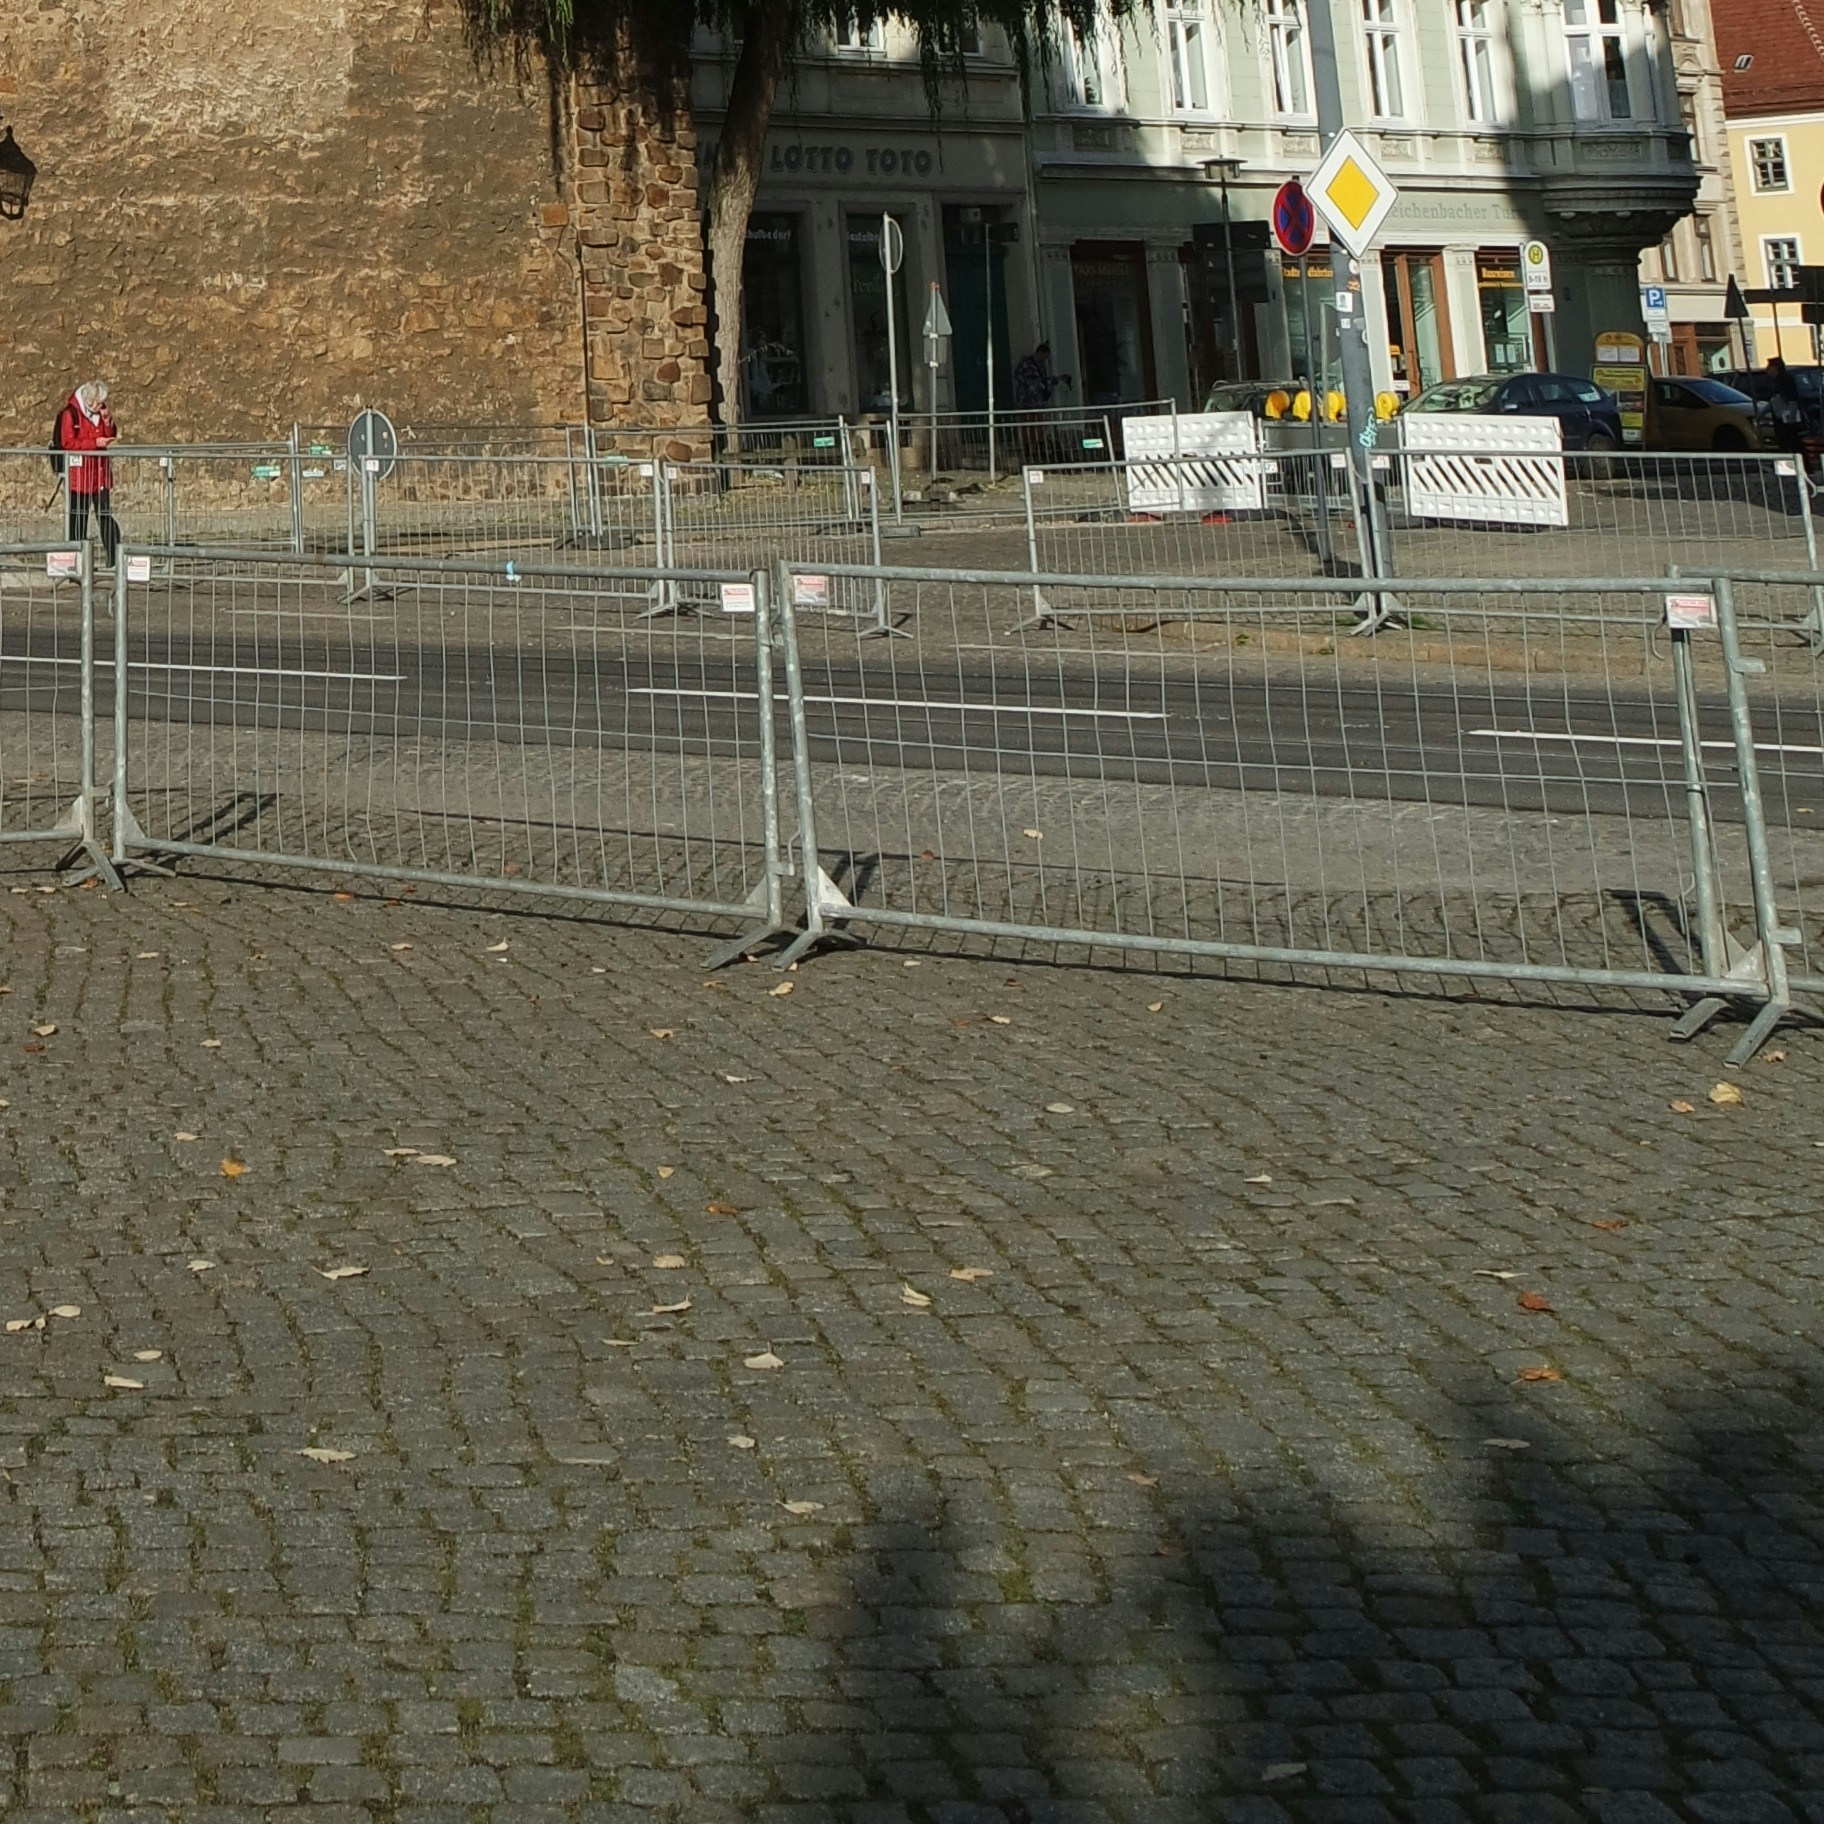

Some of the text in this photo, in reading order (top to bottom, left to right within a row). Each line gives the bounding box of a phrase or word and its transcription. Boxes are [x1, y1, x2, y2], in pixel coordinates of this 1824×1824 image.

[771, 145, 854, 174] LOTTO
[866, 148, 933, 176] TOTO
[1387, 202, 1487, 220] eichenbacher
[1649, 290, 1661, 305] P
